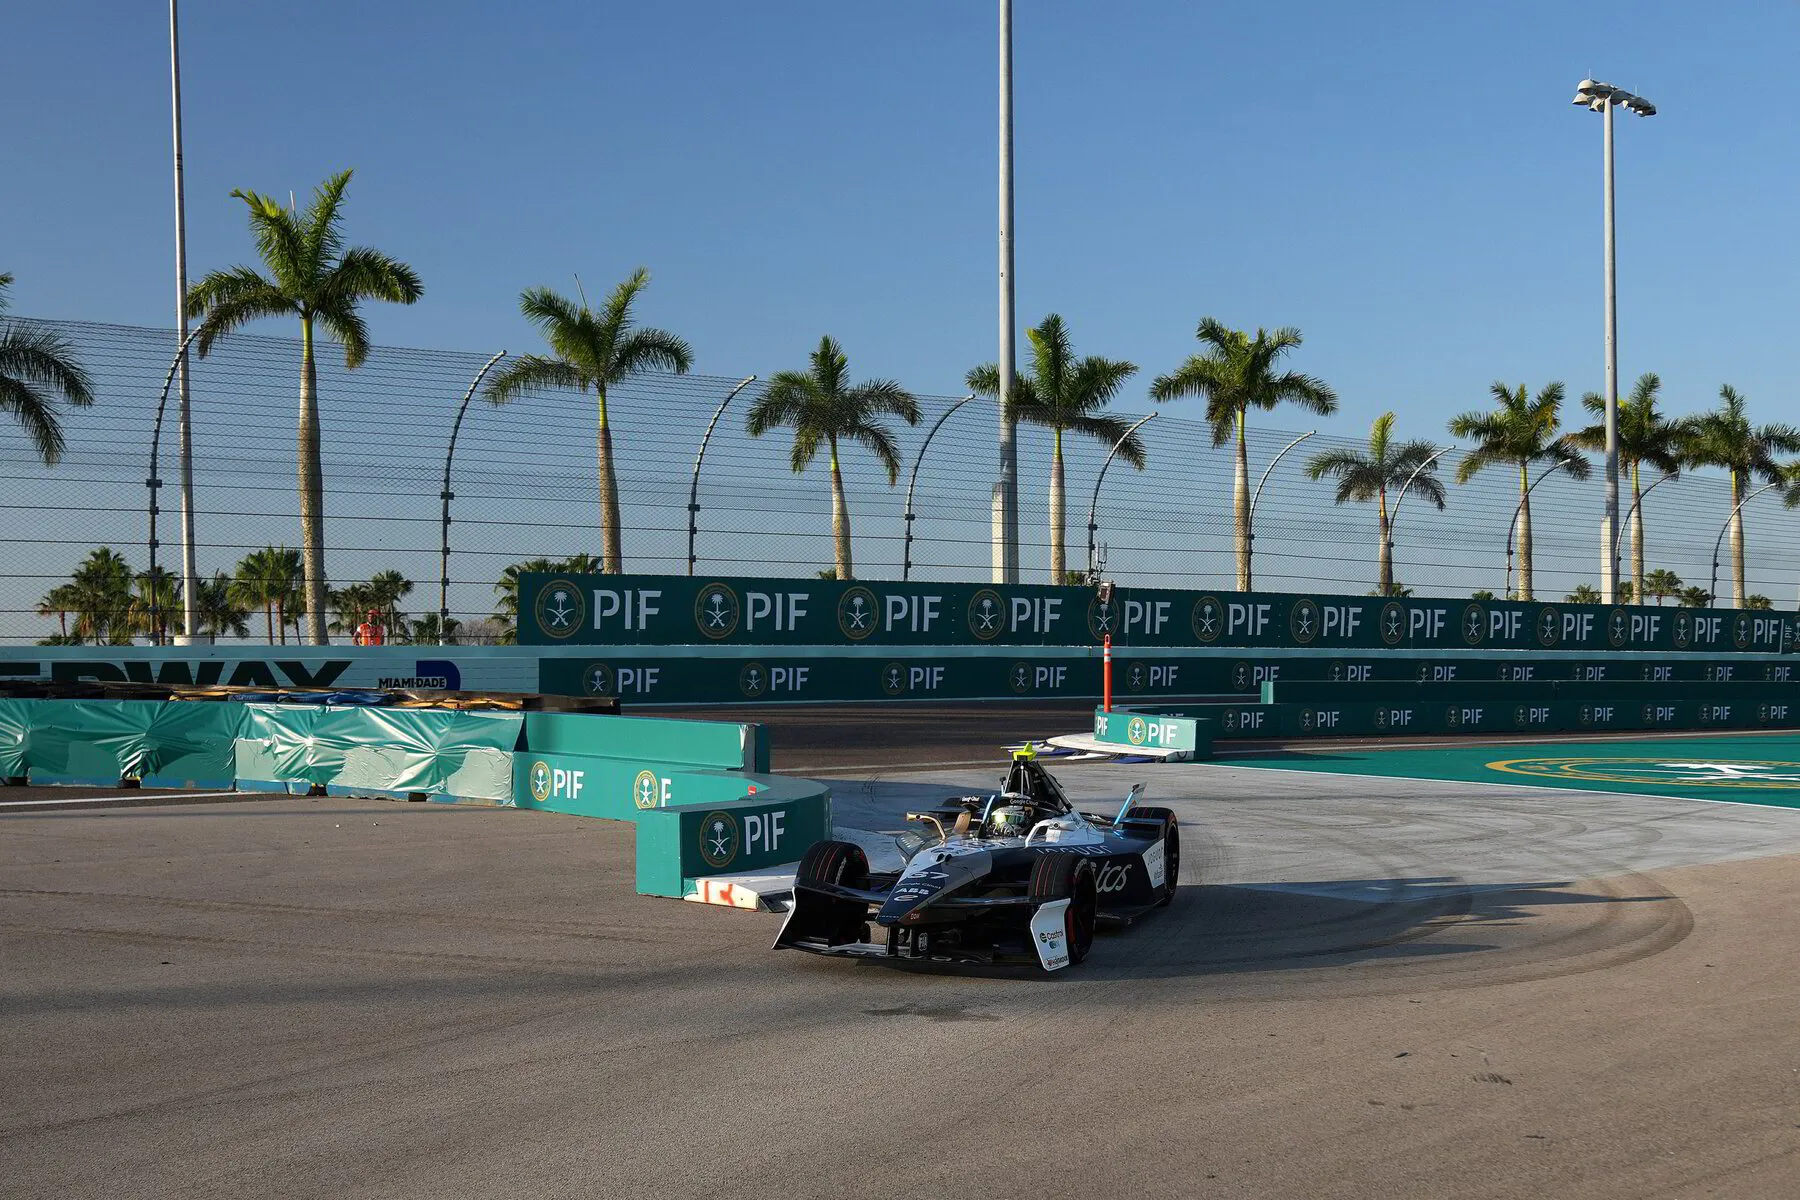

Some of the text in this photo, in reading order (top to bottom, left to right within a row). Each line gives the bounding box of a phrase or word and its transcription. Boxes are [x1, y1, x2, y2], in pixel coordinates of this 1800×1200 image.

[593, 589, 662, 630] PIF
[746, 592, 809, 631] PIF
[885, 595, 942, 632] PIF
[1011, 598, 1062, 633] PIF
[1124, 601, 1171, 635] PIF
[1228, 603, 1271, 636] PIF
[1323, 606, 1362, 637] PIF
[1409, 609, 1446, 638] PIF
[1489, 611, 1523, 639] PIF
[1562, 613, 1594, 641] PIF
[1631, 615, 1660, 642] PIF
[1695, 617, 1721, 643] PIF
[1753, 619, 1779, 643] PIF
[618, 668, 659, 693] PIF
[771, 667, 809, 691] PIF
[910, 667, 945, 689] PIF
[1035, 666, 1067, 688] PIF
[1150, 666, 1178, 686] PIF
[1253, 666, 1280, 685] PIF
[1347, 665, 1372, 681] PIF
[1433, 666, 1456, 681] PIF
[1513, 666, 1534, 681] PIF
[1586, 666, 1606, 681] PIF
[1653, 666, 1672, 681] PIF
[1716, 666, 1733, 681] PIF
[1774, 667, 1790, 681] PIF
[1240, 712, 1264, 728] PIF
[1317, 711, 1340, 727] PIF
[1390, 710, 1412, 726] PIF
[1462, 708, 1483, 724] PIF
[1529, 707, 1550, 723] PIF
[1594, 707, 1614, 722] PIF
[1656, 707, 1675, 721] PIF
[1712, 706, 1731, 720] PIF
[1770, 706, 1788, 719] PIF
[1097, 715, 1108, 736] PIF
[1147, 722, 1178, 744] PIF
[553, 769, 584, 799] PIF
[1010, 798, 1026, 806] Google
[744, 811, 786, 855] PIF
[895, 887, 929, 895] ABB
